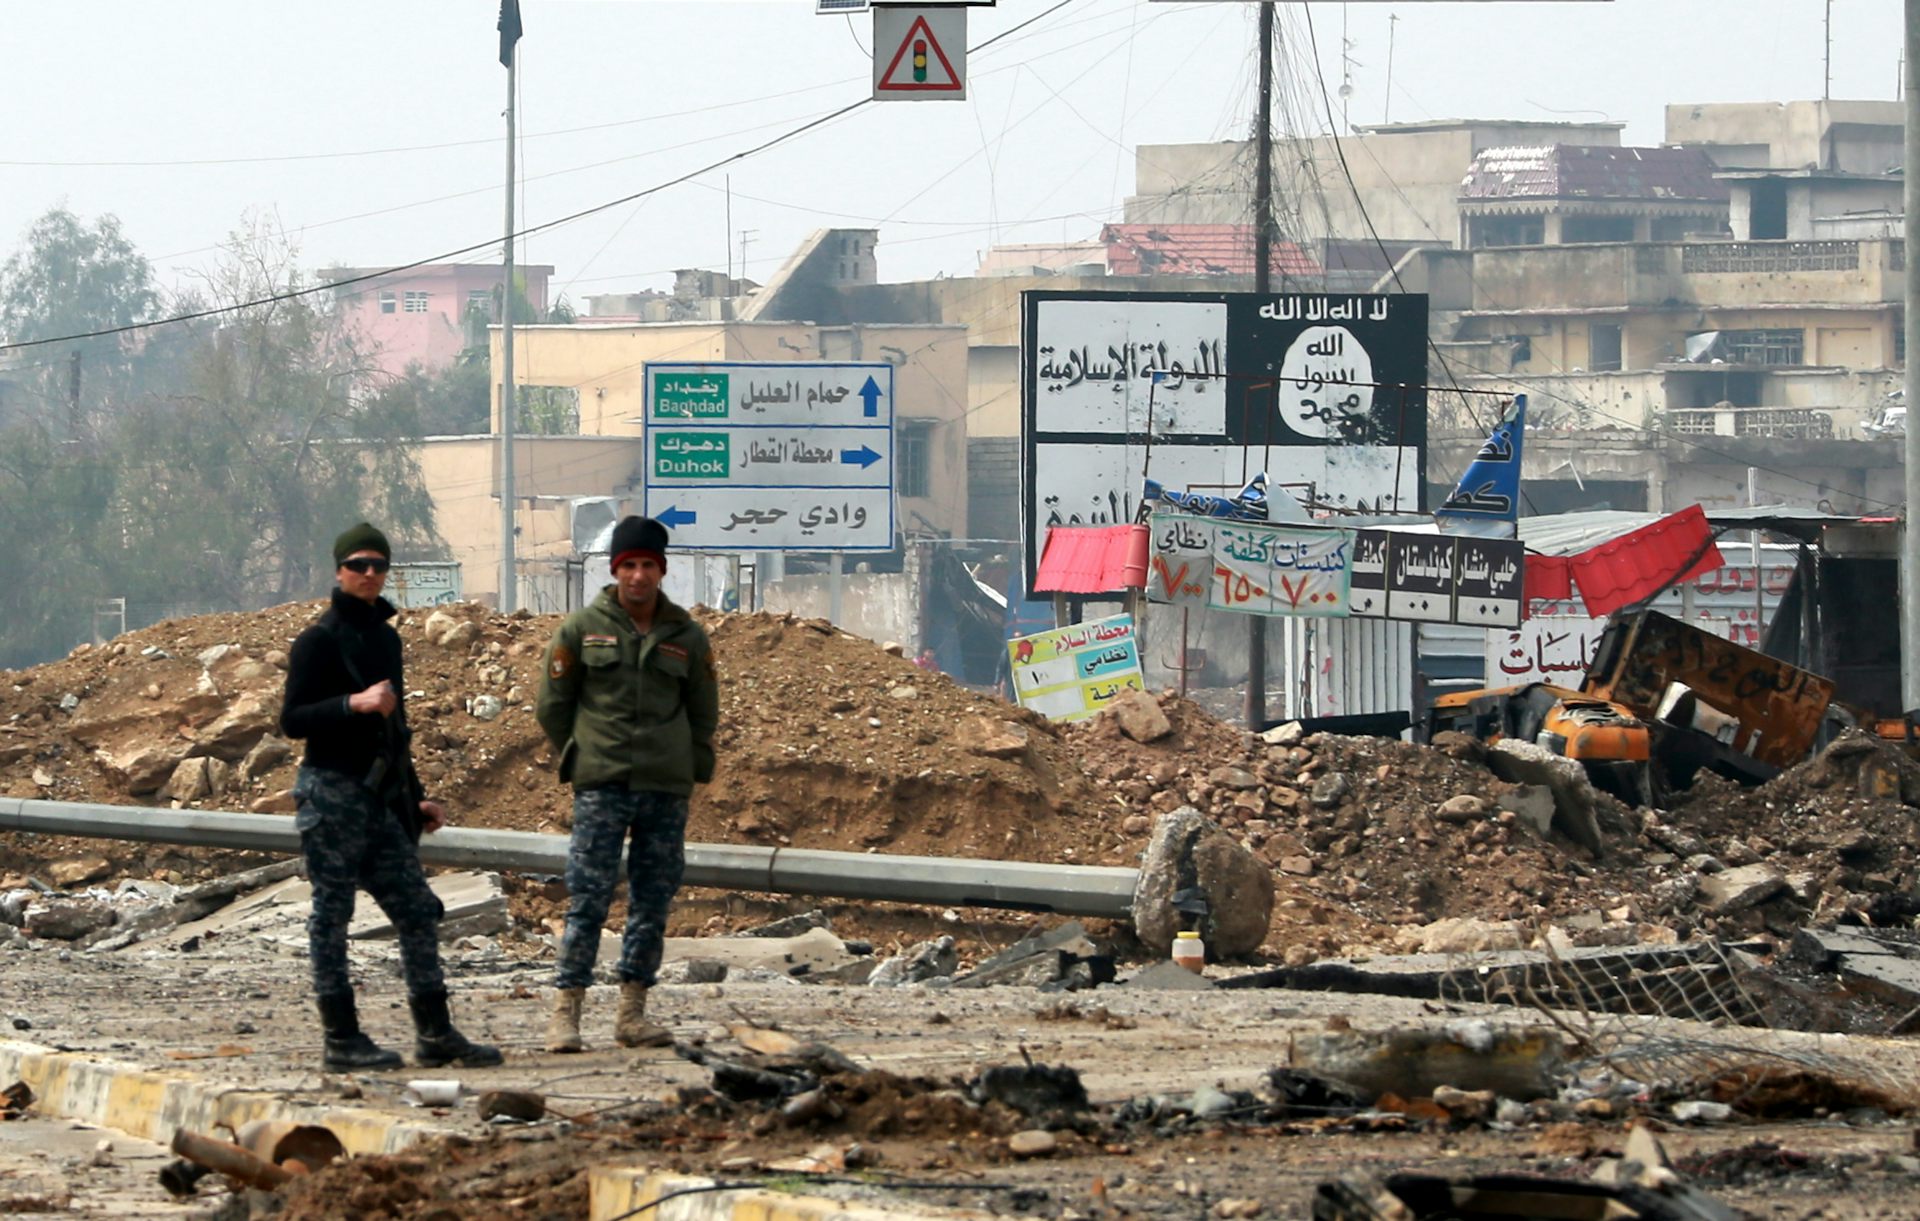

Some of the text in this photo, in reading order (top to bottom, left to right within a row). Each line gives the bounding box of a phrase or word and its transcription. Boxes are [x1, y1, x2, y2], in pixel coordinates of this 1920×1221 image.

[1259, 296, 1301, 320] الله
[1369, 297, 1387, 320] لا
[1306, 333, 1343, 356] الله
[1040, 339, 1221, 392] الدولة الإسلامية
[663, 379, 719, 397] بغداد
[741, 380, 850, 413] حمام العليل
[660, 399, 725, 417] Baghdad
[1300, 393, 1360, 427] محمد
[661, 438, 725, 454] دهوك
[739, 437, 833, 469] محطة القطار
[659, 459, 724, 473] Duhok
[720, 502, 867, 535] وادي حجر
[1156, 522, 1207, 553] نظامي
[1056, 624, 1129, 655] محطة السلام
[1085, 646, 1128, 675] نظامي
